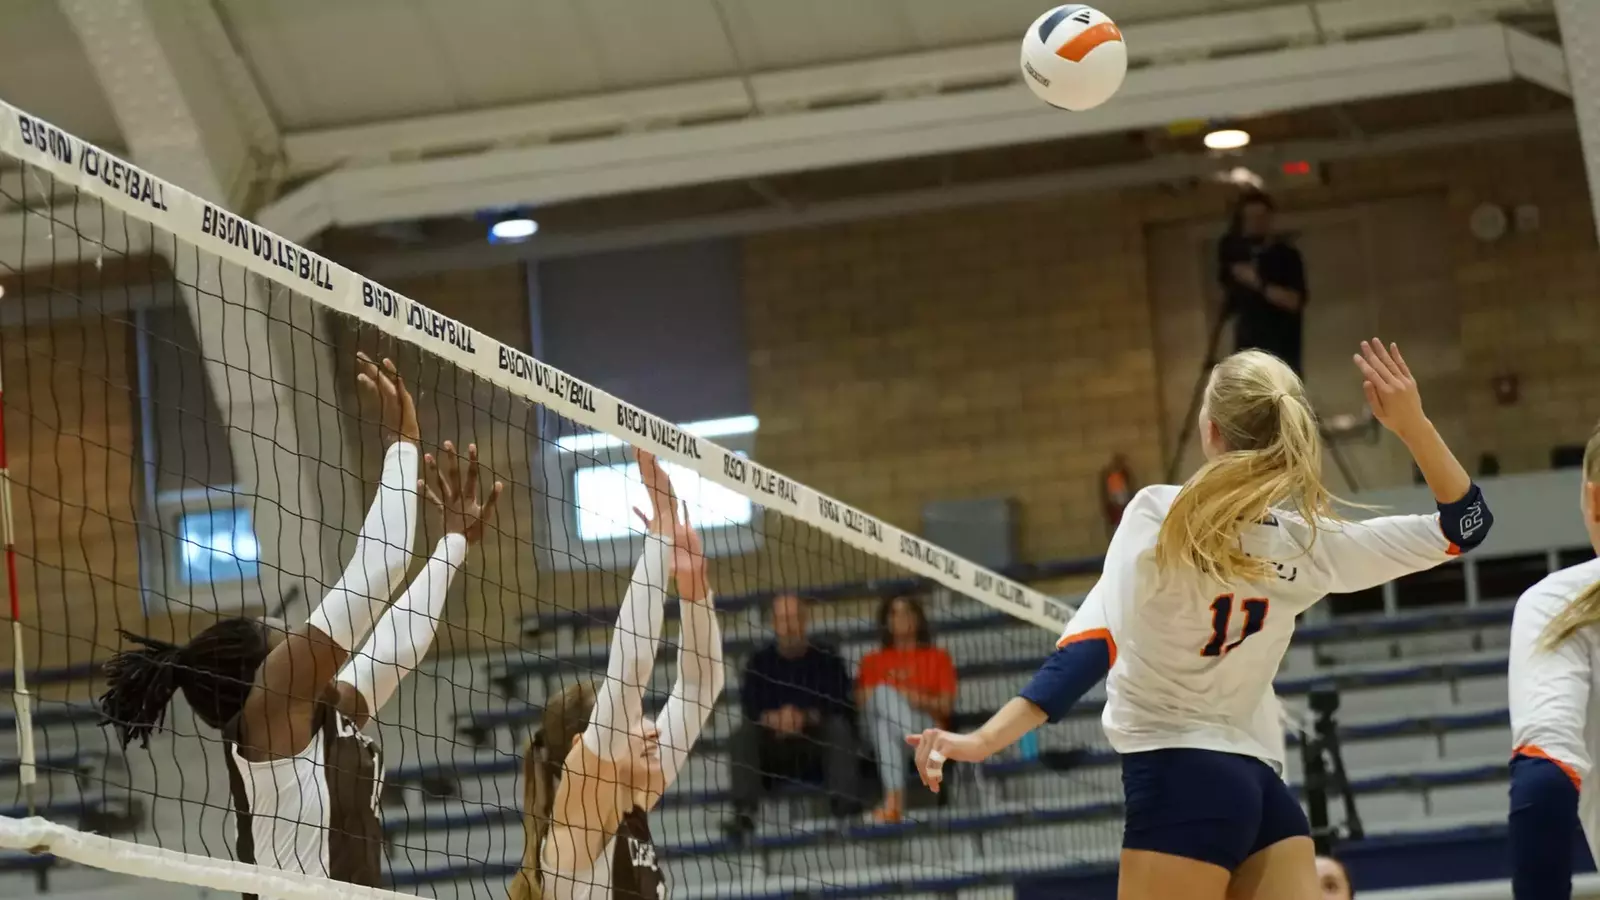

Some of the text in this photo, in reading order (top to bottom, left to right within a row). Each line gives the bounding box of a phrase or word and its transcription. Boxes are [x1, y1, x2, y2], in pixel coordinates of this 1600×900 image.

[19, 115, 72, 164] BISON
[201, 205, 333, 291] BISON VOLLEYBALL
[404, 301, 476, 354] VOLLEYBALL
[498, 346, 596, 413] BISON VOLLEYBALL
[617, 403, 647, 437] BISON
[751, 466, 798, 505] VOLLEBALL
[1200, 592, 1269, 657] 11
